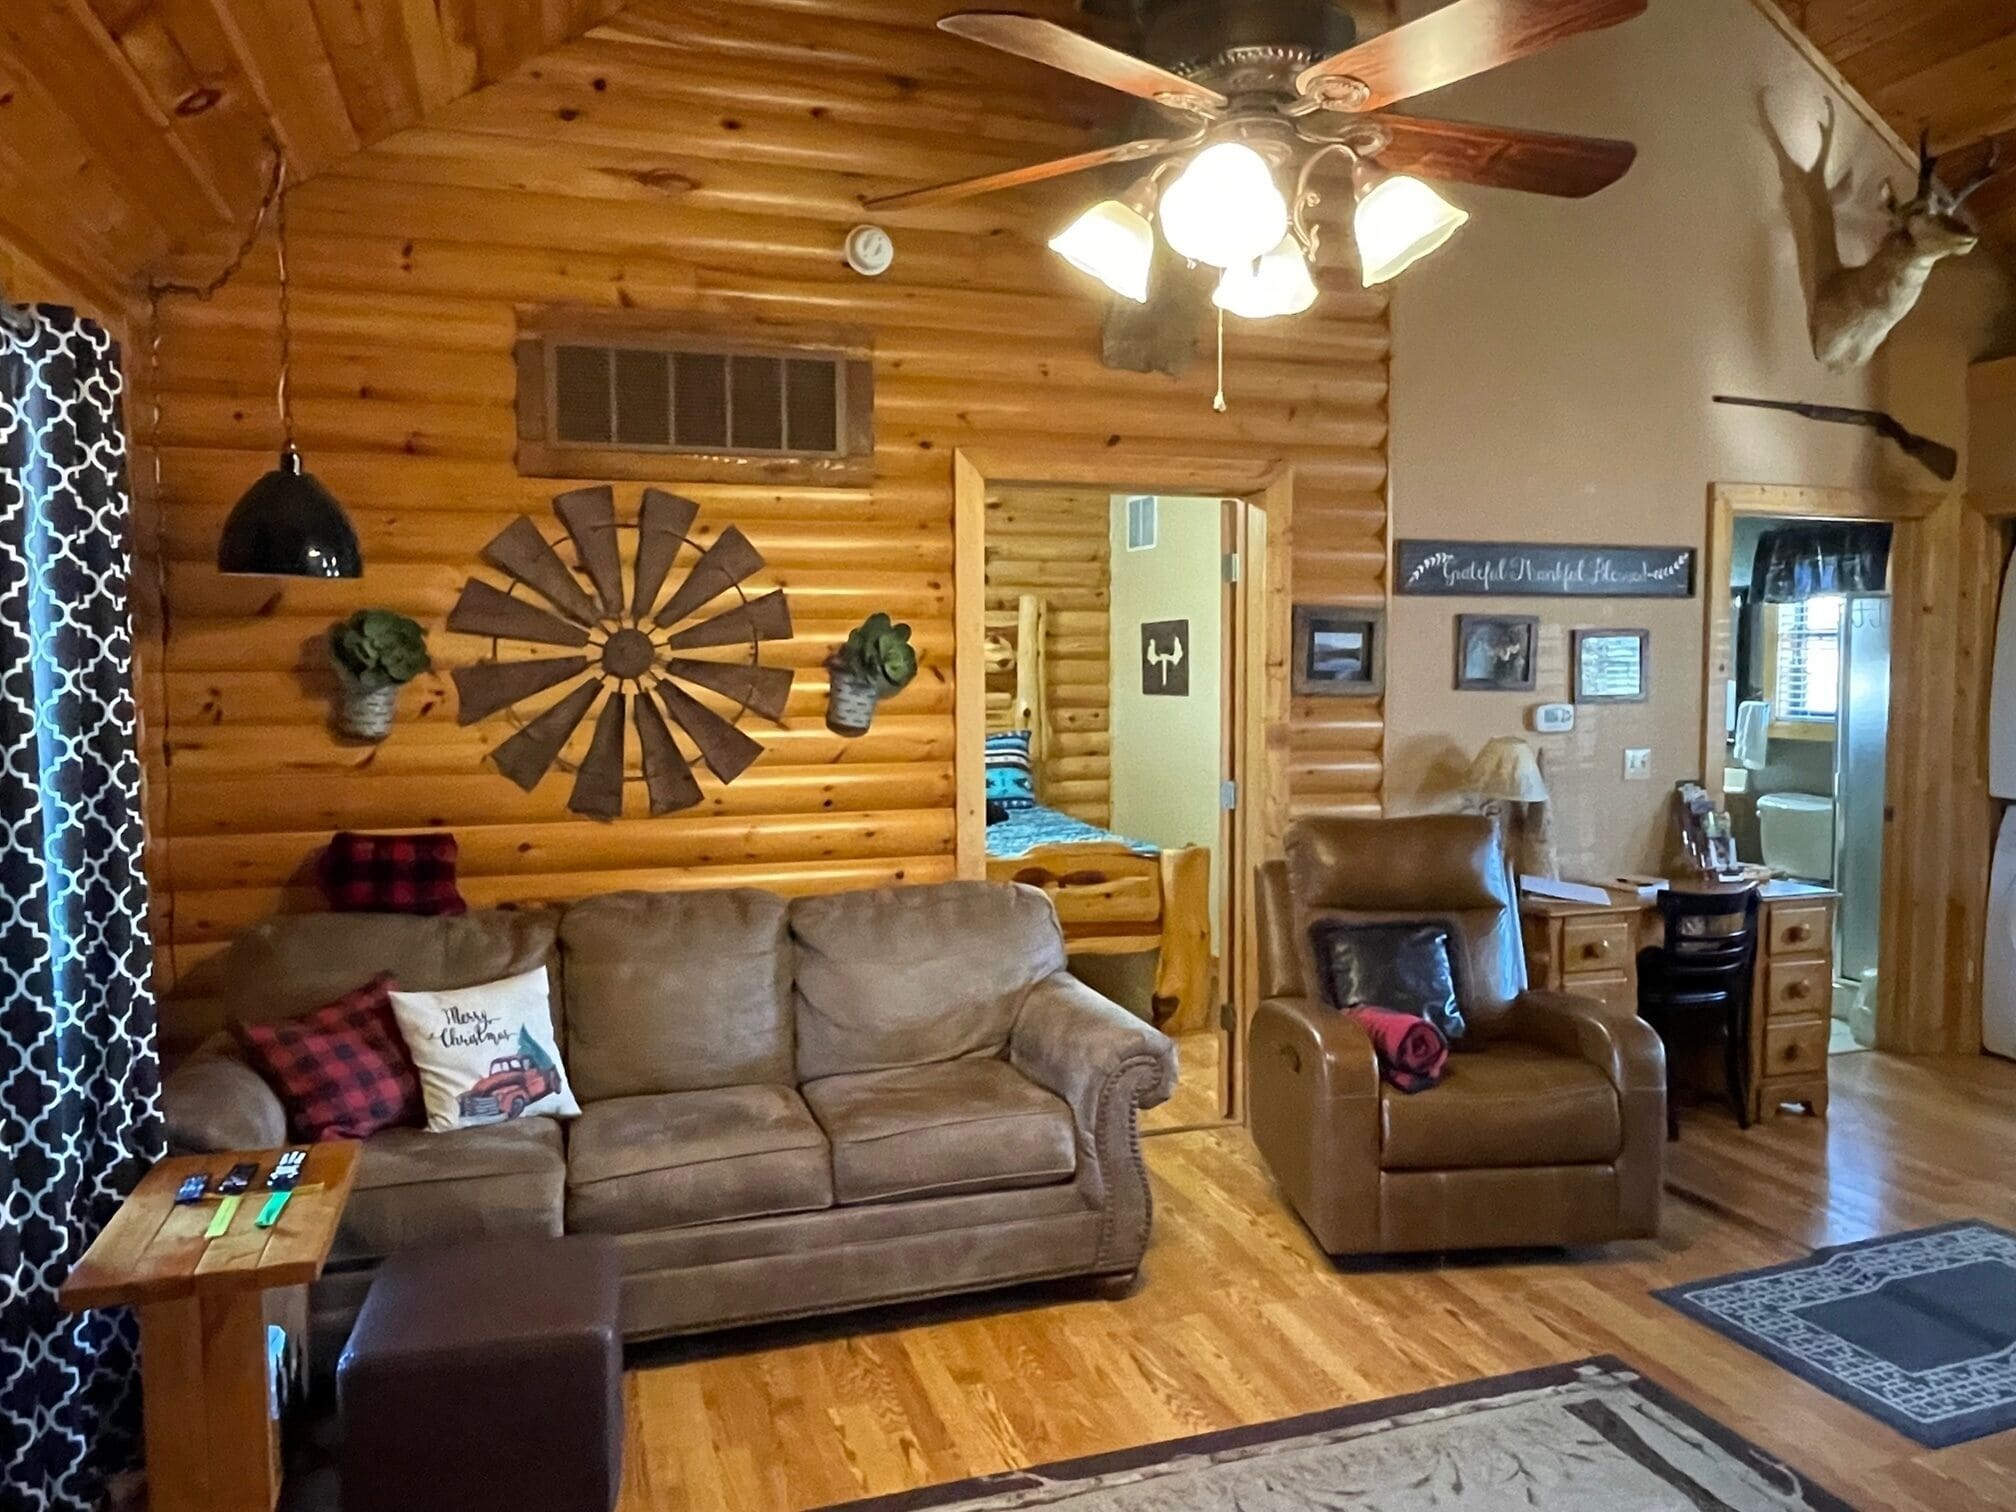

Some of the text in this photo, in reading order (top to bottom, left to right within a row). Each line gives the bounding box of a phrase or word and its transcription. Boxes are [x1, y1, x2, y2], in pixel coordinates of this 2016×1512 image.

[1443, 558, 1505, 591] Grateful
[1510, 558, 1584, 591] Thankful
[442, 1006, 499, 1029] Merry
[432, 1026, 516, 1048] Christmas
